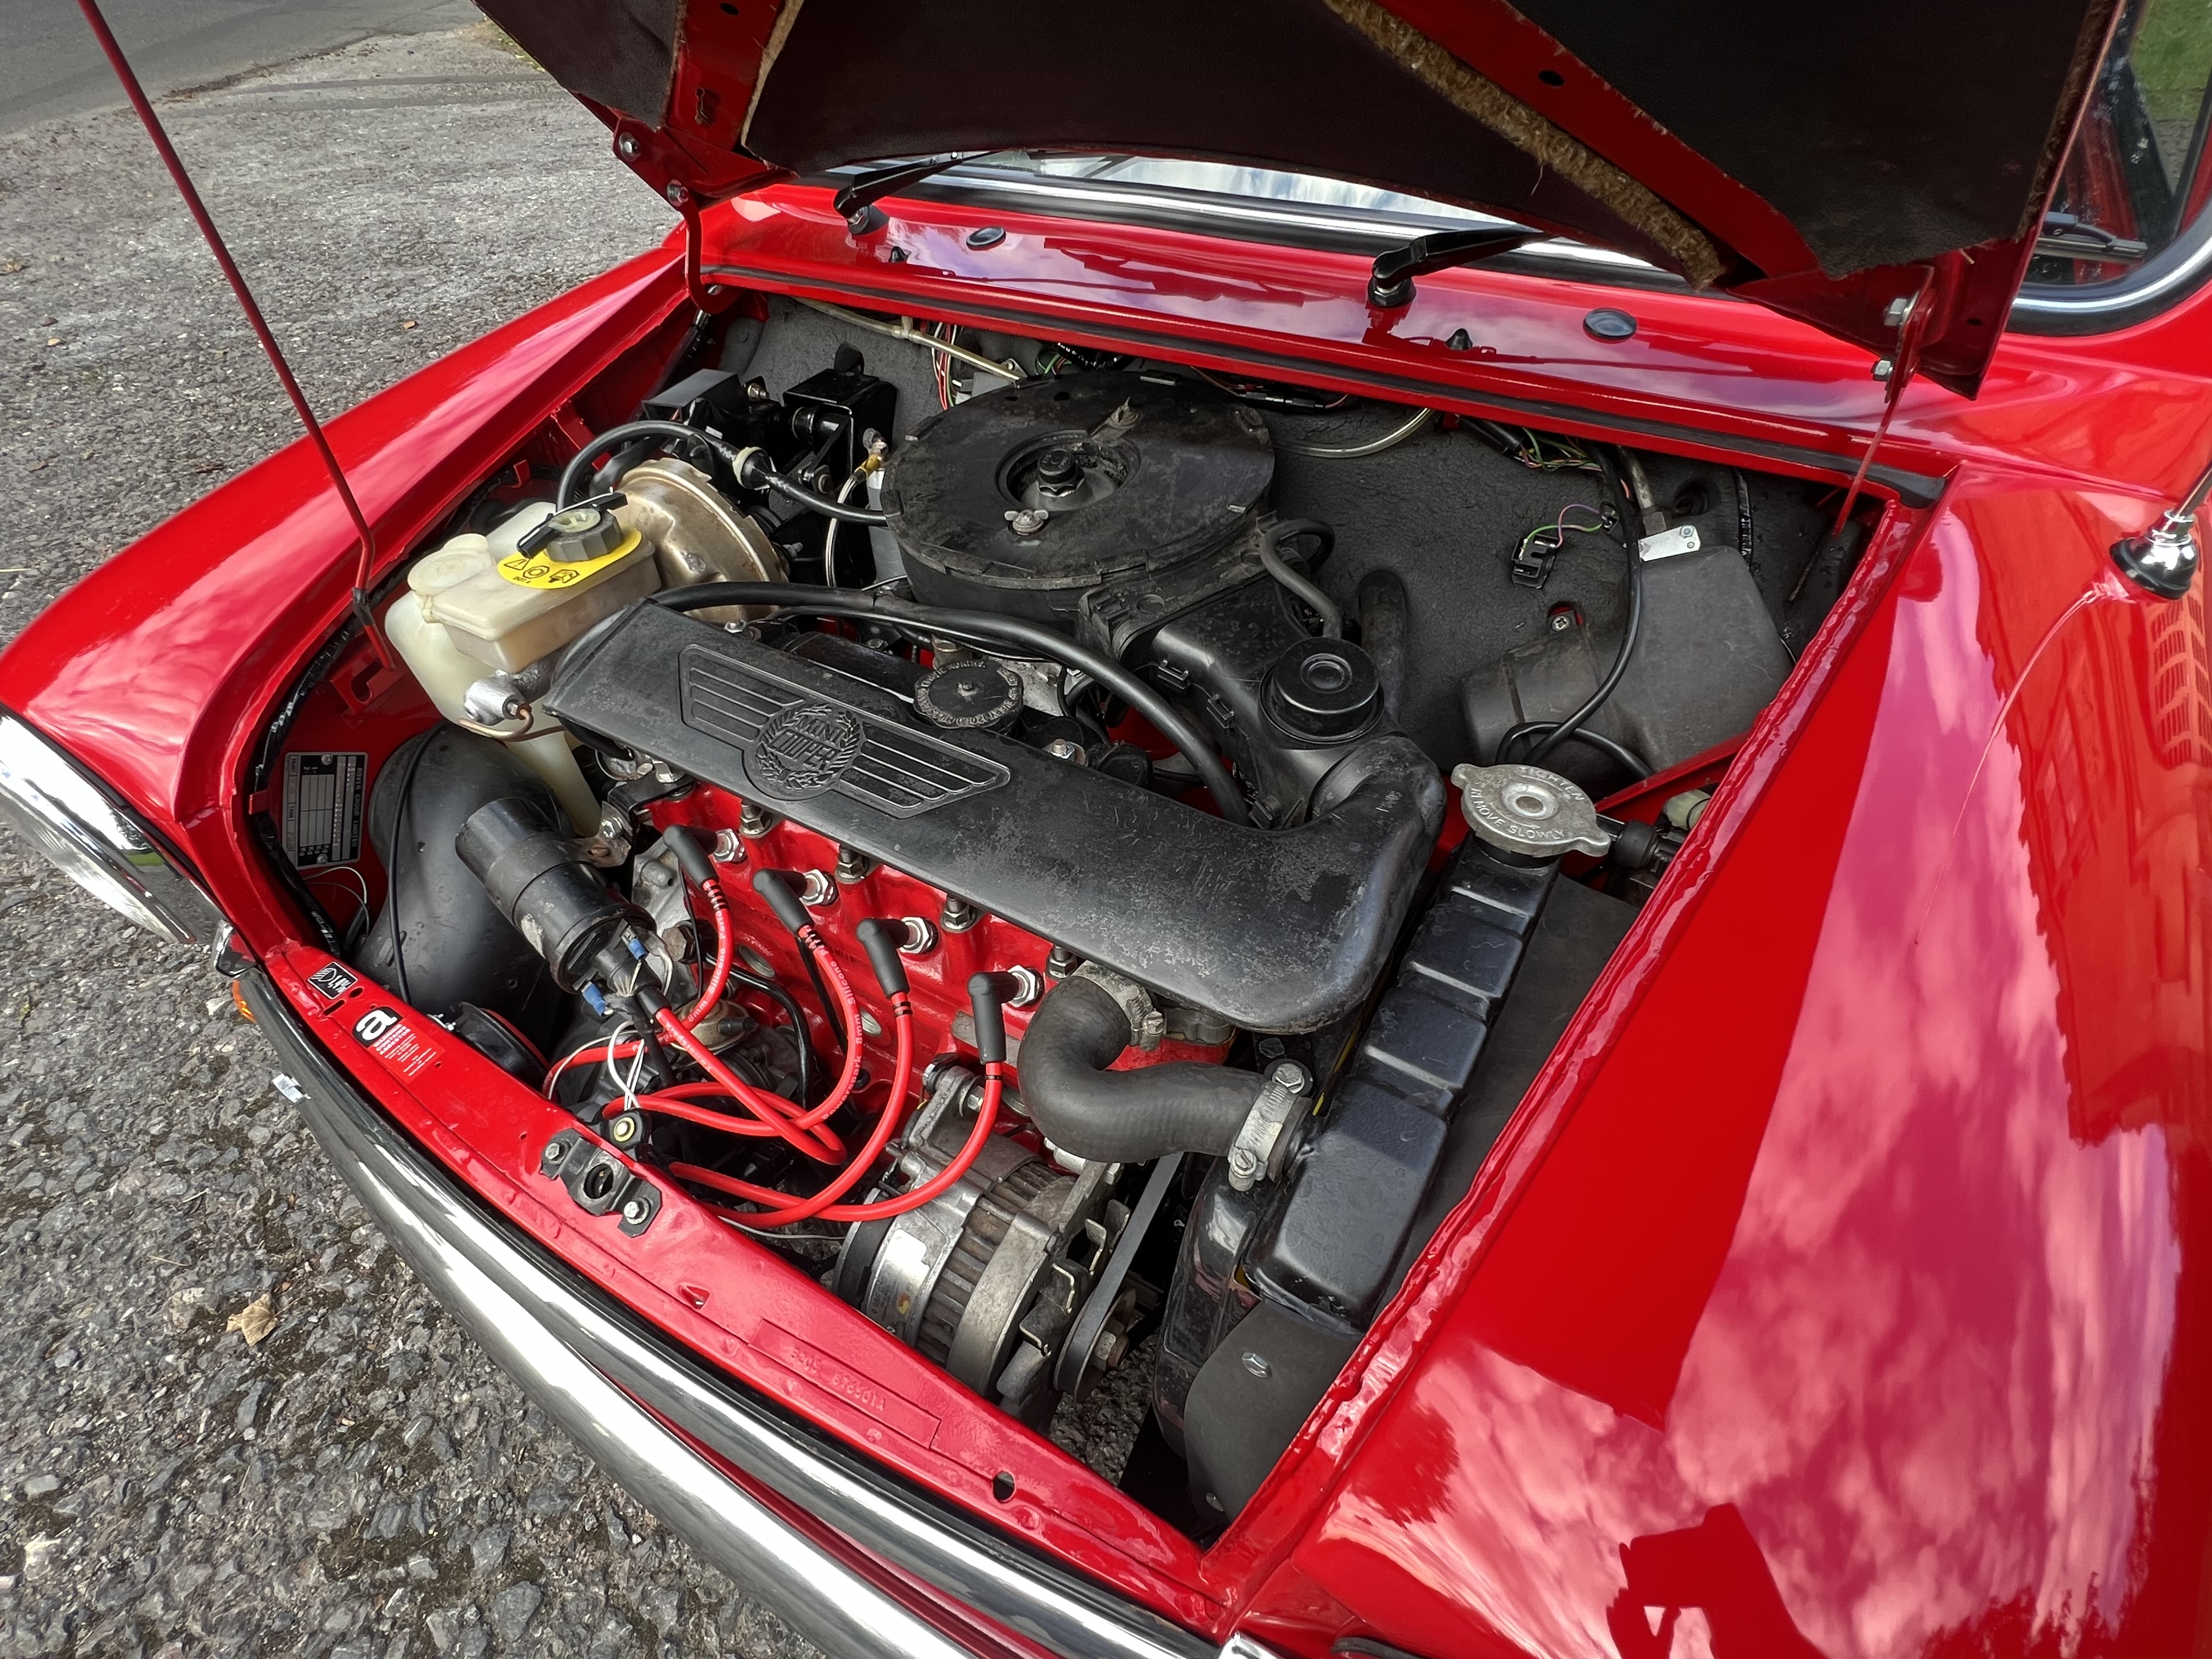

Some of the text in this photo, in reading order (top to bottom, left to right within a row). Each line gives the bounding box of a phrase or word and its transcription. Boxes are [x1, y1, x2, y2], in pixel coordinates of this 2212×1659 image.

[768, 729, 842, 773] COOPER
[795, 715, 845, 747] MINI
[1518, 765, 1585, 802] TIGHTEN
[1507, 824, 1565, 840] SLOWLY
[687, 1000, 708, 1023] 8mm
[708, 947, 726, 995] Silicone
[822, 961, 864, 1120] Powerspark 8mm Silicone
